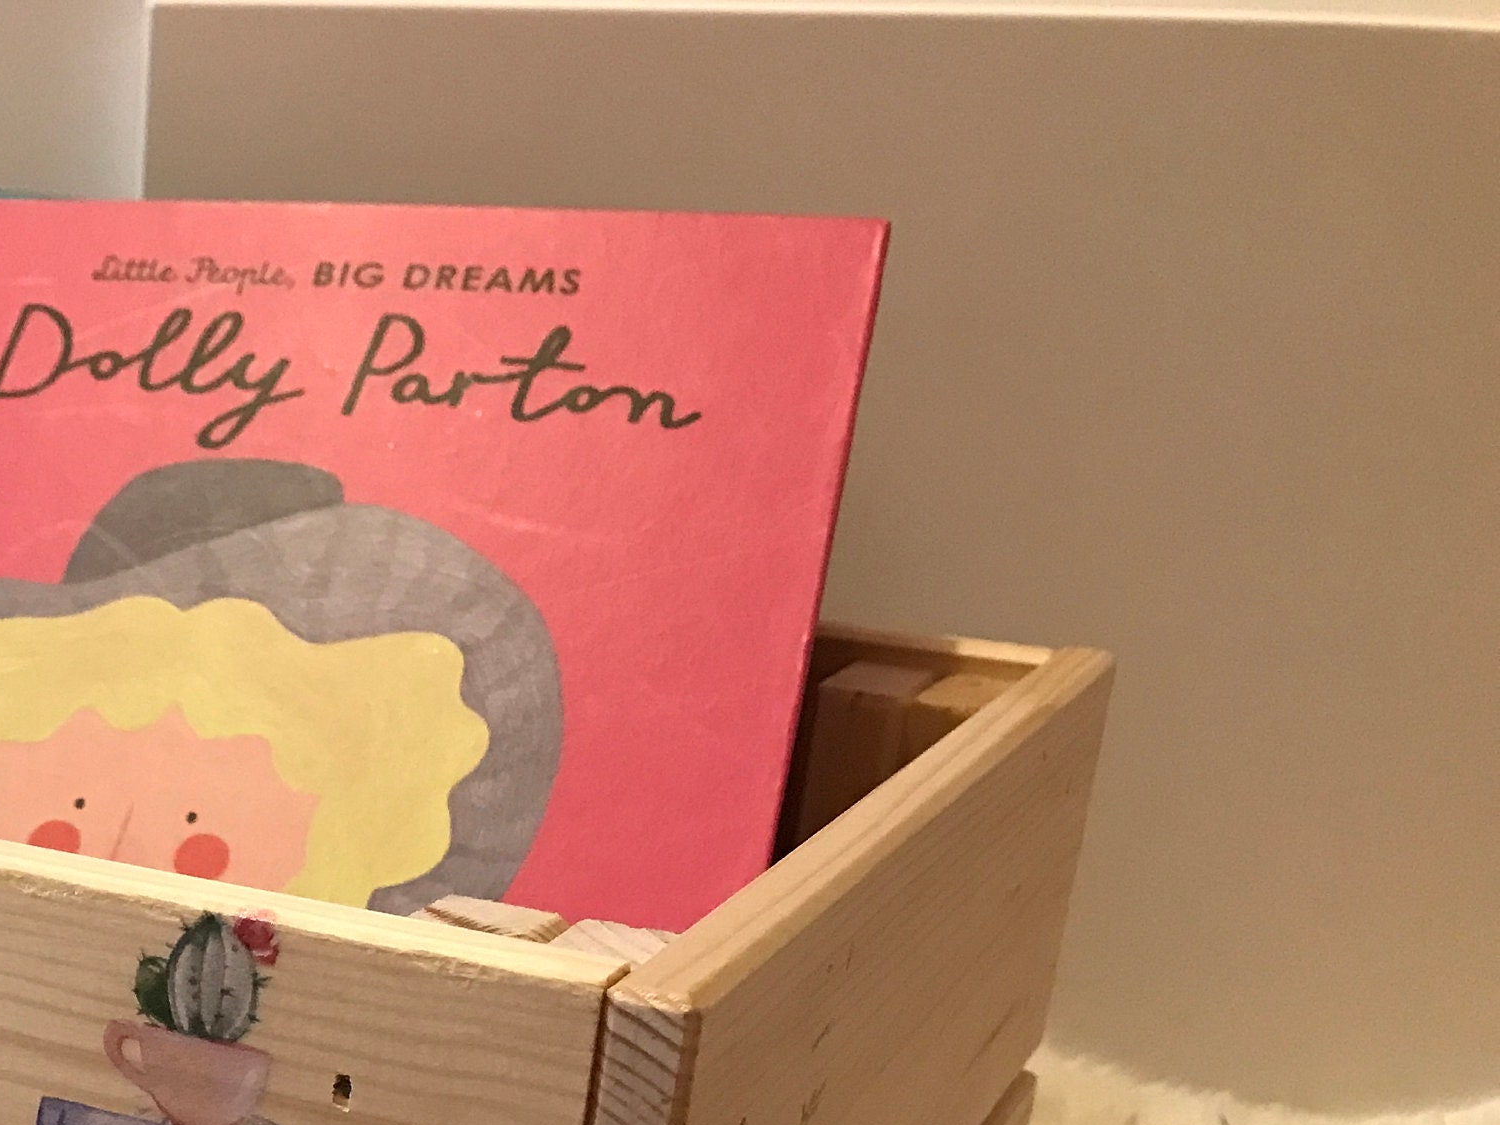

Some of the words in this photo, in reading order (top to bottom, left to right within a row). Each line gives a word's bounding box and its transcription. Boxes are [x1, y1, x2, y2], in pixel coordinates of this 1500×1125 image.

[91, 254, 178, 282] Little
[312, 260, 385, 289] BIG
[402, 262, 582, 296] DREAMS
[340, 311, 702, 430] Parton
